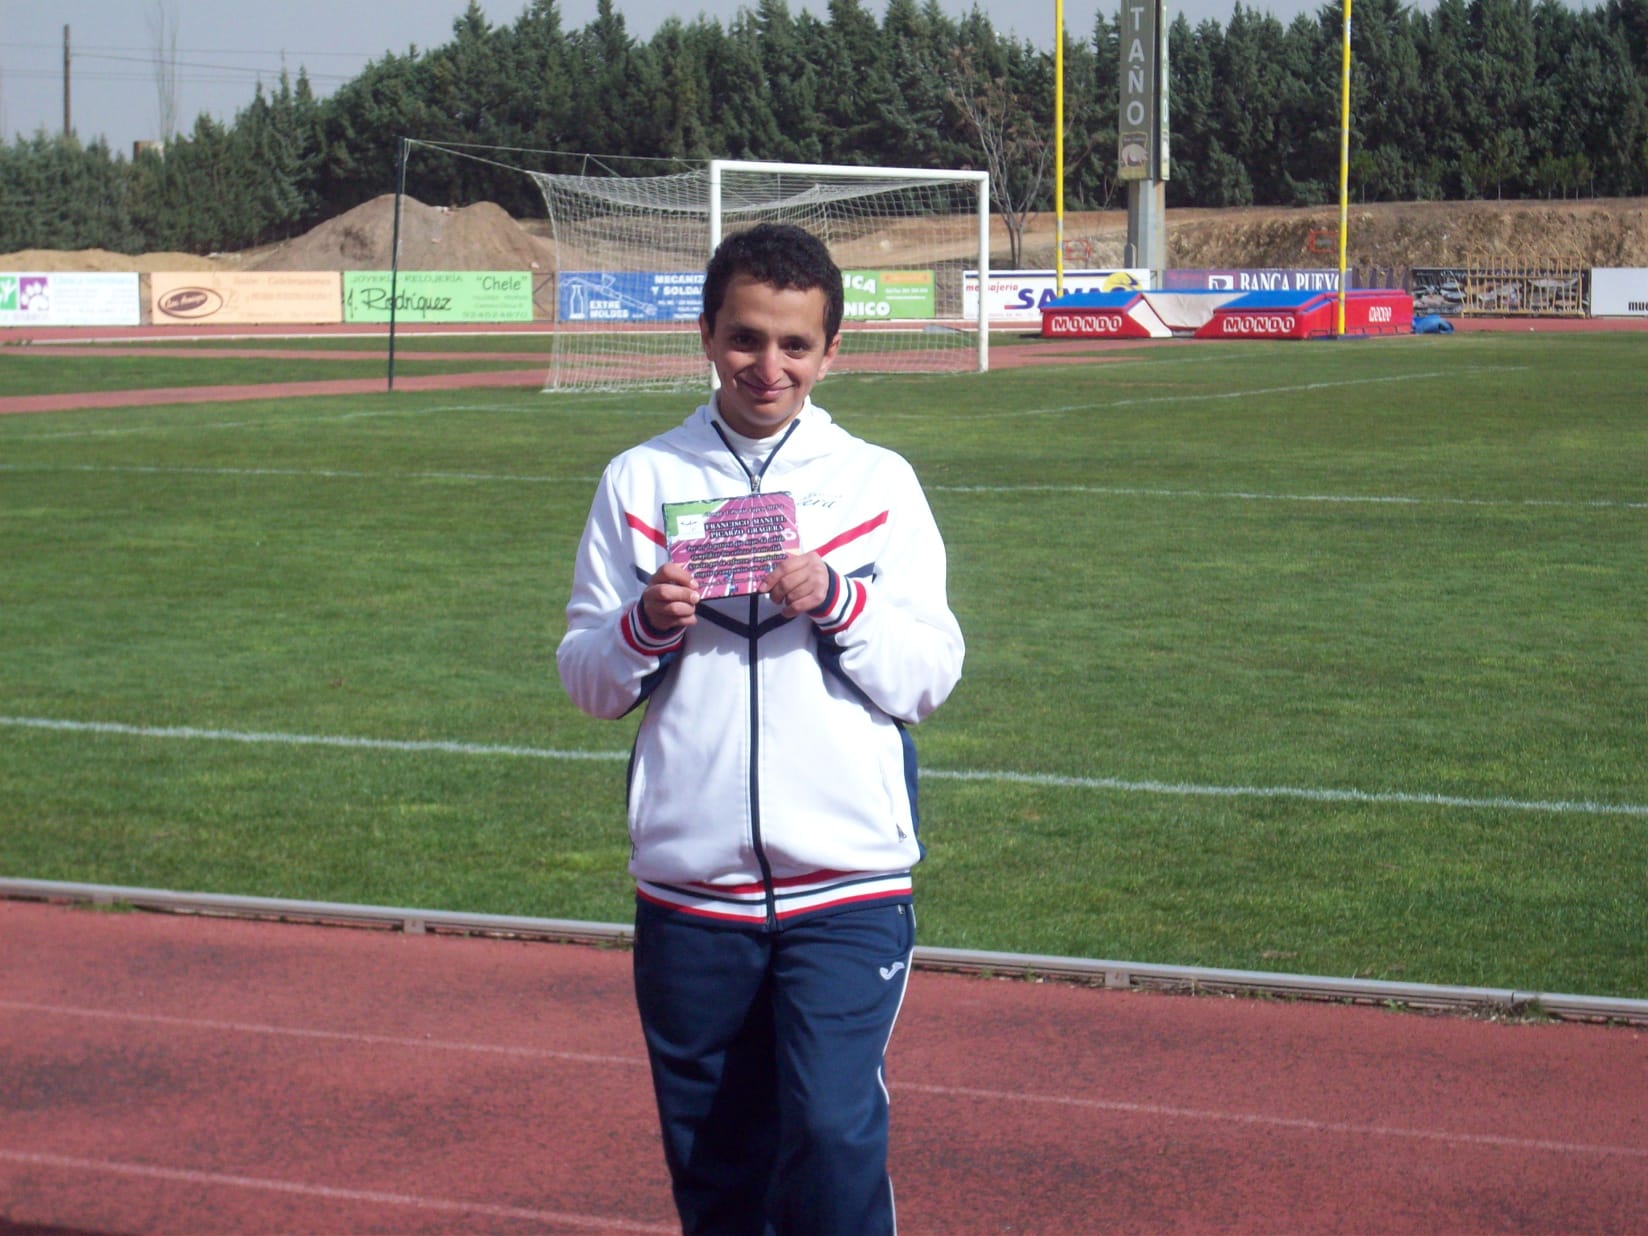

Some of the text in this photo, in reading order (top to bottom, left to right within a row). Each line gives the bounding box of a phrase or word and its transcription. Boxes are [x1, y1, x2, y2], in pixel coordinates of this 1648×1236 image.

[654, 274, 704, 284] MECANIZ
[842, 274, 876, 295] ICA
[1240, 272, 1290, 291] BANCA
[663, 286, 703, 296] SOLDA
[843, 301, 890, 316] NICO
[1051, 315, 1123, 332] MONDO
[1223, 316, 1295, 333] MONDO
[704, 515, 784, 530] FRANCISCO MANUEL
